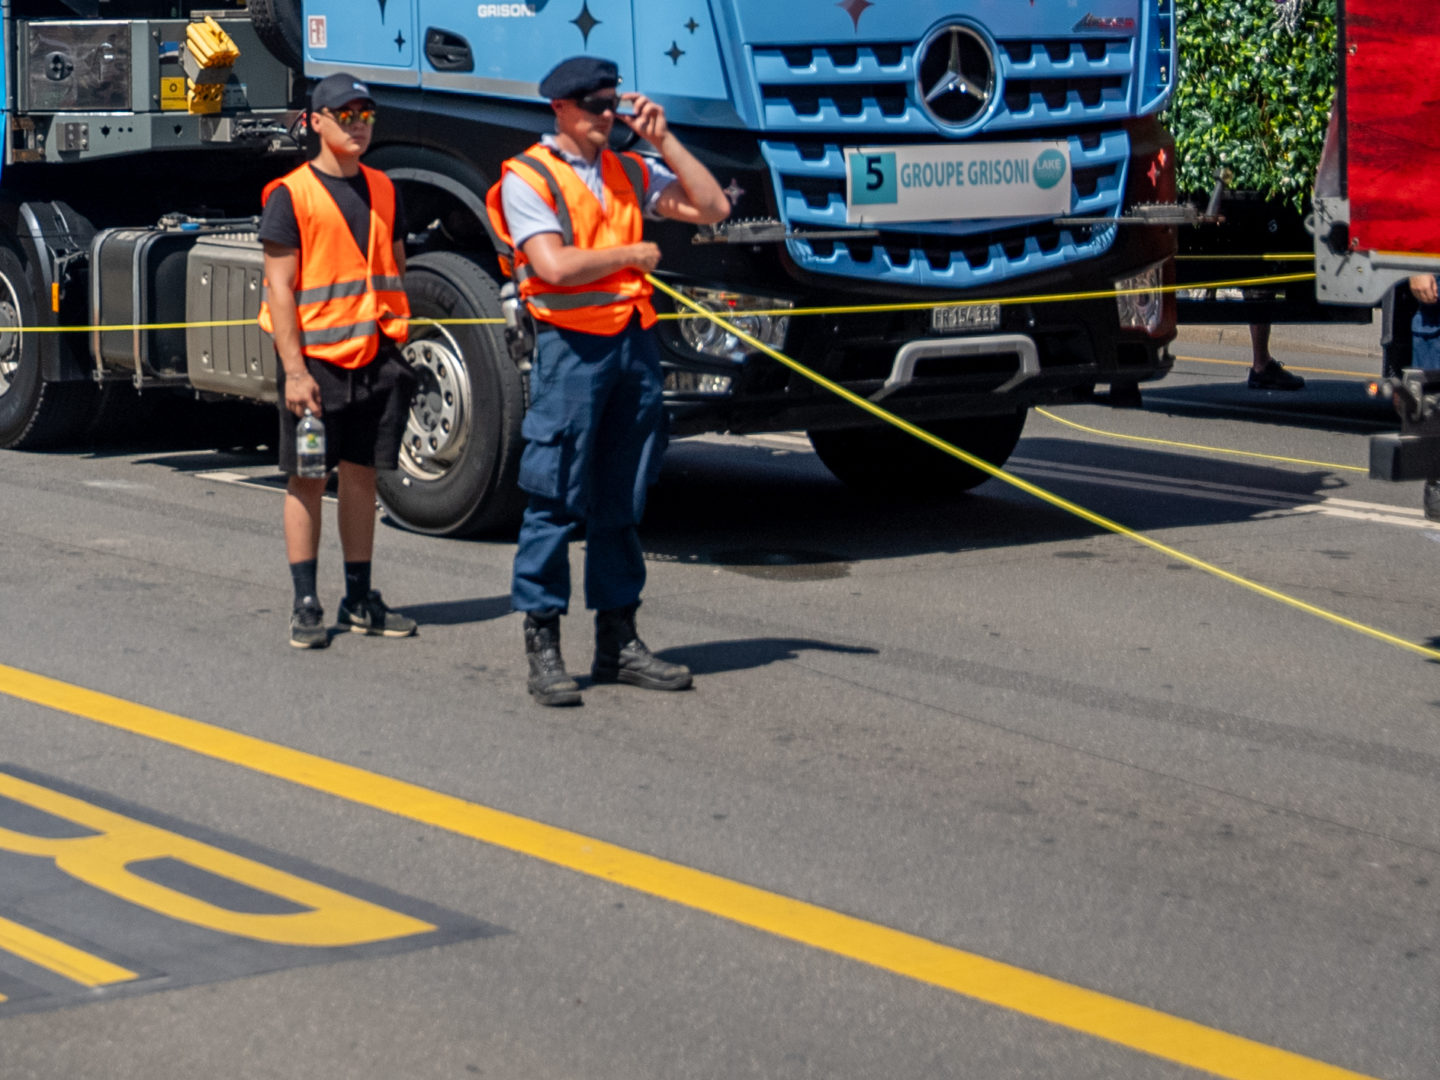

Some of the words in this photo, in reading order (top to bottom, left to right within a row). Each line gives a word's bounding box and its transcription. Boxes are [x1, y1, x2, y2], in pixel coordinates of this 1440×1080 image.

[477, 3, 536, 19] GRISONI
[1036, 158, 1062, 170] LAKE
[865, 155, 885, 191] 5
[900, 160, 965, 188] GROUPE
[967, 158, 1030, 186] GRISONI
